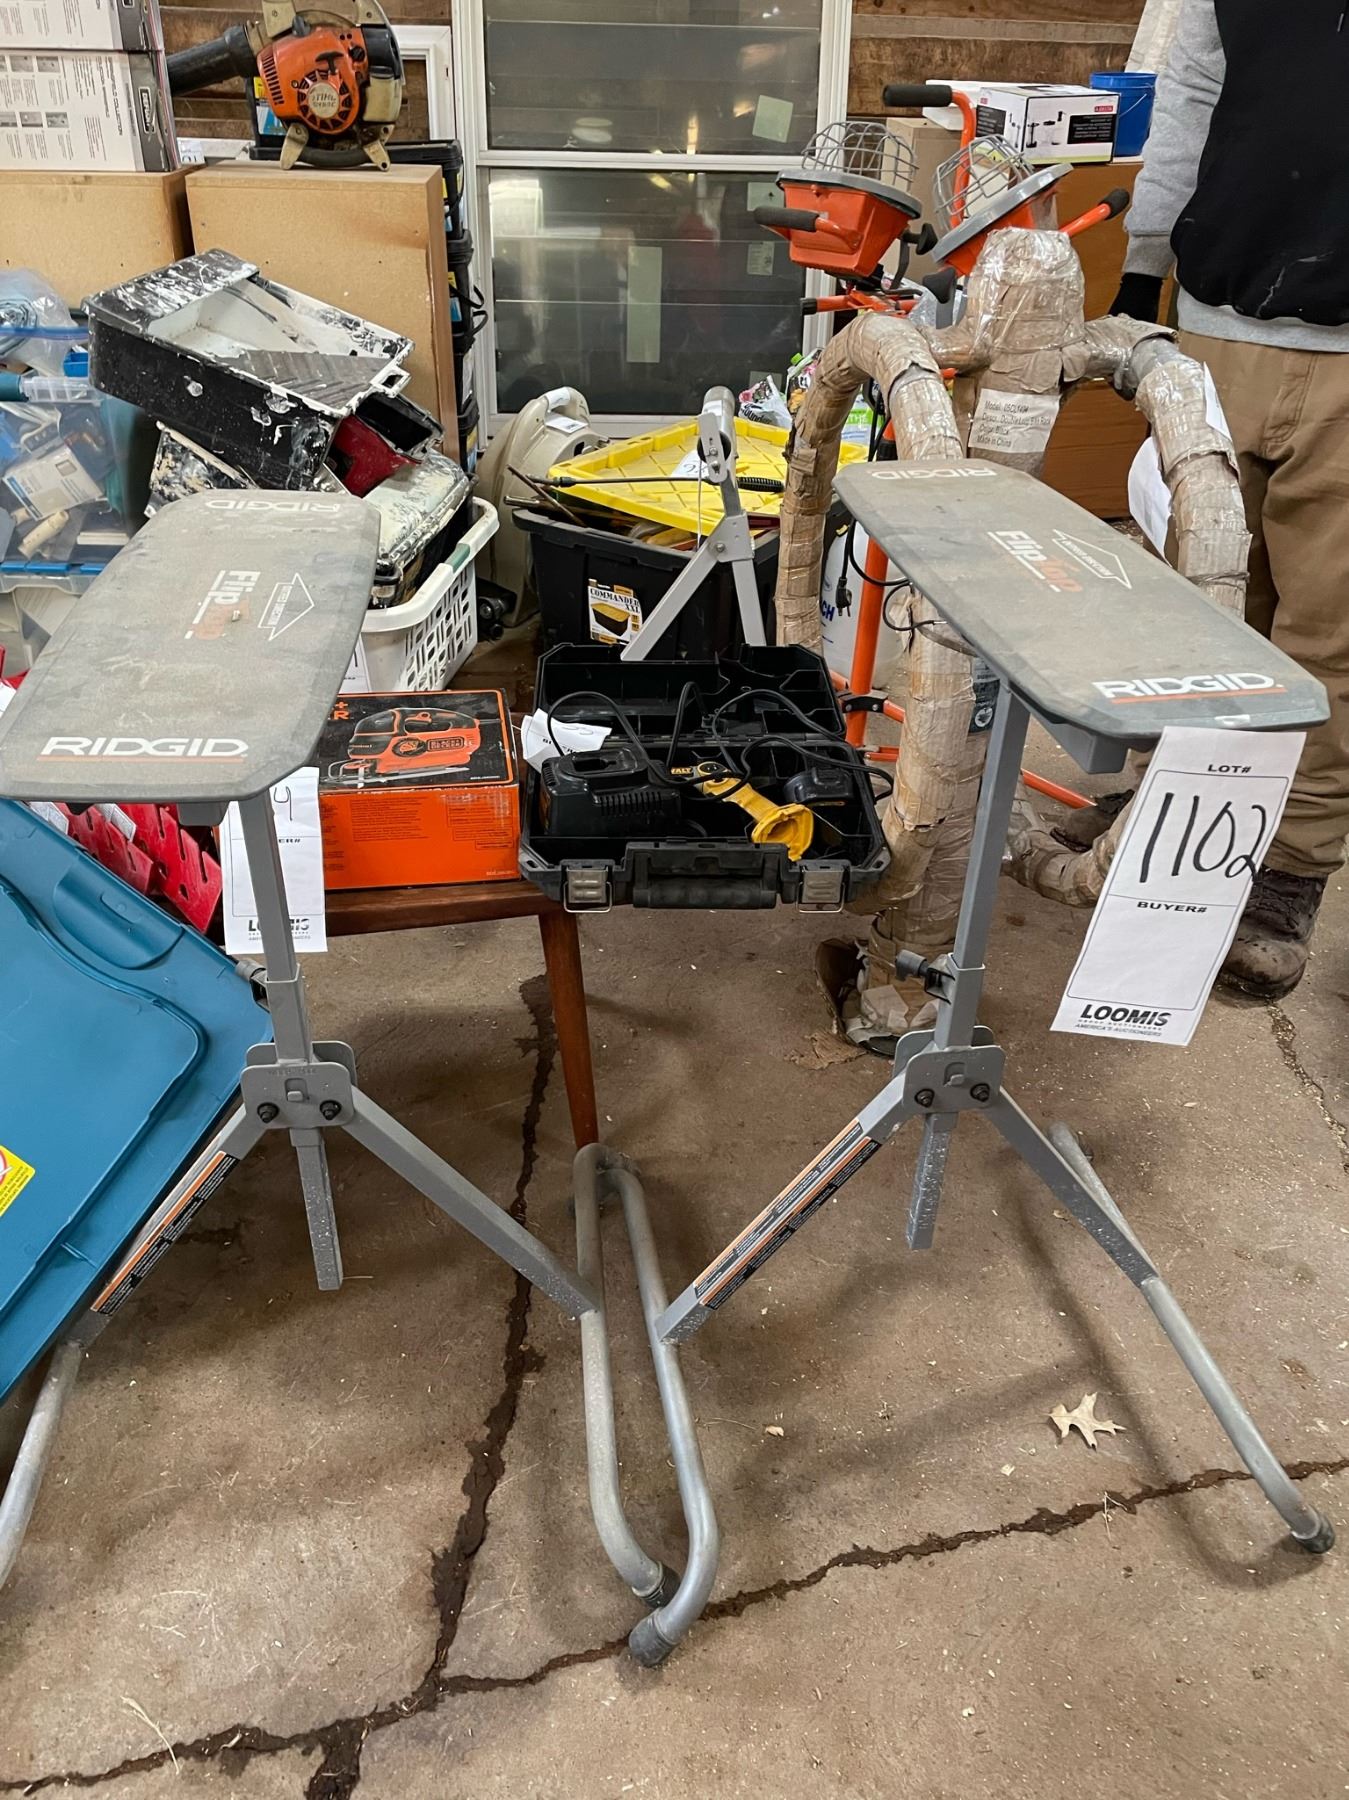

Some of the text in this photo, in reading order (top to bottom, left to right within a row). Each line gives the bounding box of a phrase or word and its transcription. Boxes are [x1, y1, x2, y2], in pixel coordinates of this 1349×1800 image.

[871, 467, 997, 479] RIDGID
[205, 499, 340, 512] RIDGID
[590, 588, 640, 607] COMMANDER
[1092, 672, 1275, 699] RIDGID
[40, 736, 249, 758] RIDGID
[1208, 764, 1252, 773] LOT#
[1139, 792, 1267, 884] 1102
[1137, 901, 1208, 913] BUYER#
[1080, 1004, 1172, 1027] LOOMIS
